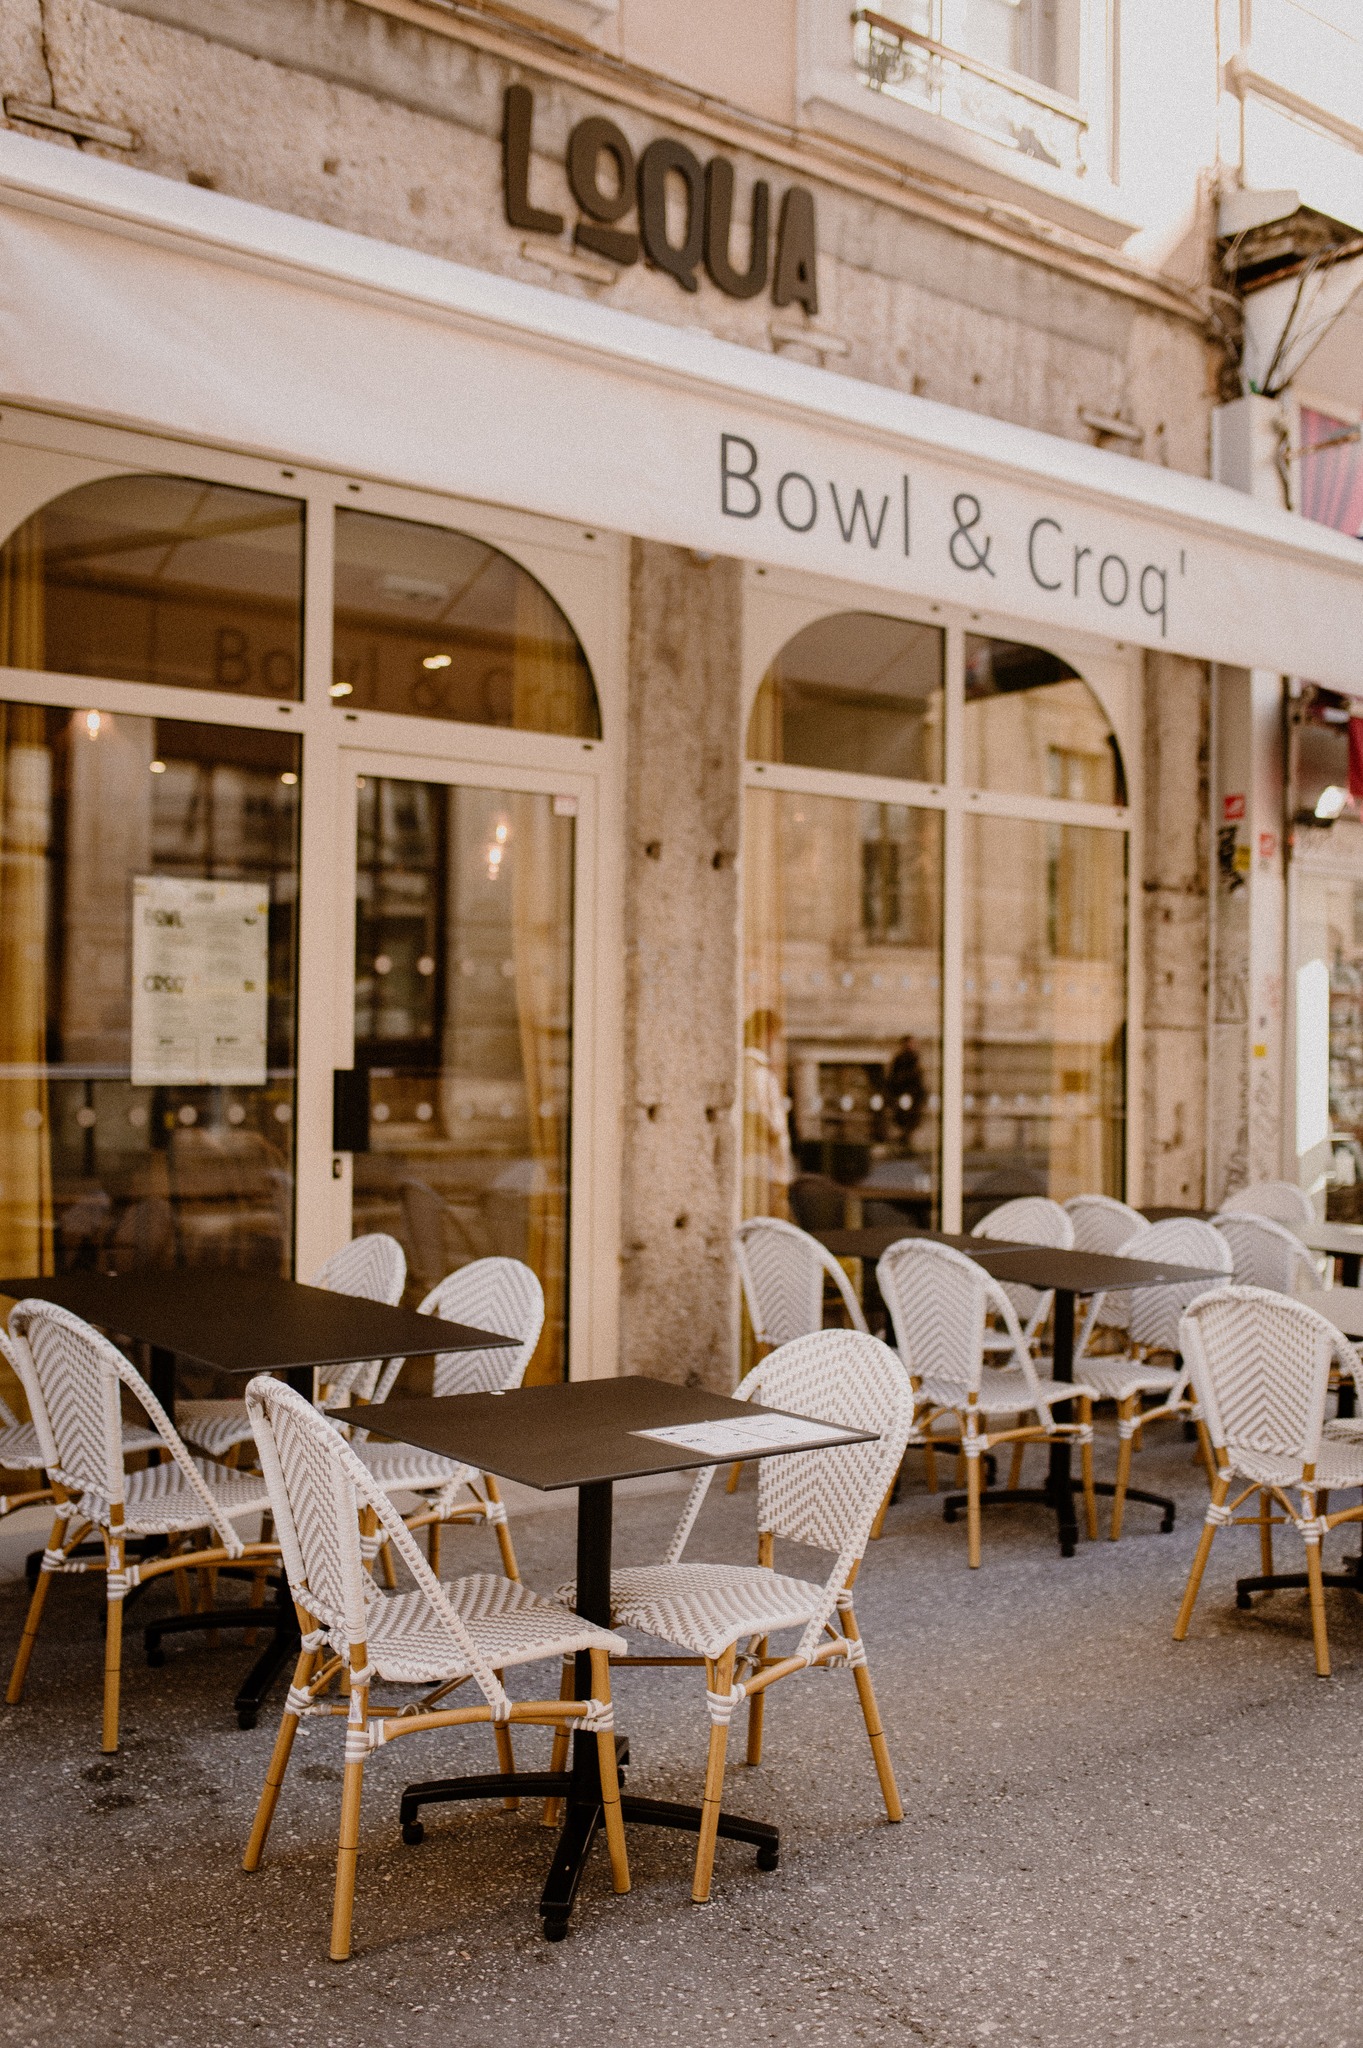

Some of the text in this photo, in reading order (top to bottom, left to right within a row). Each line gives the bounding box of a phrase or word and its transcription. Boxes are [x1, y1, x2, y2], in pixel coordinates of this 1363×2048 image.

[502, 84, 819, 316] LOQUA
[720, 433, 1186, 637] Bowl & Croq'
